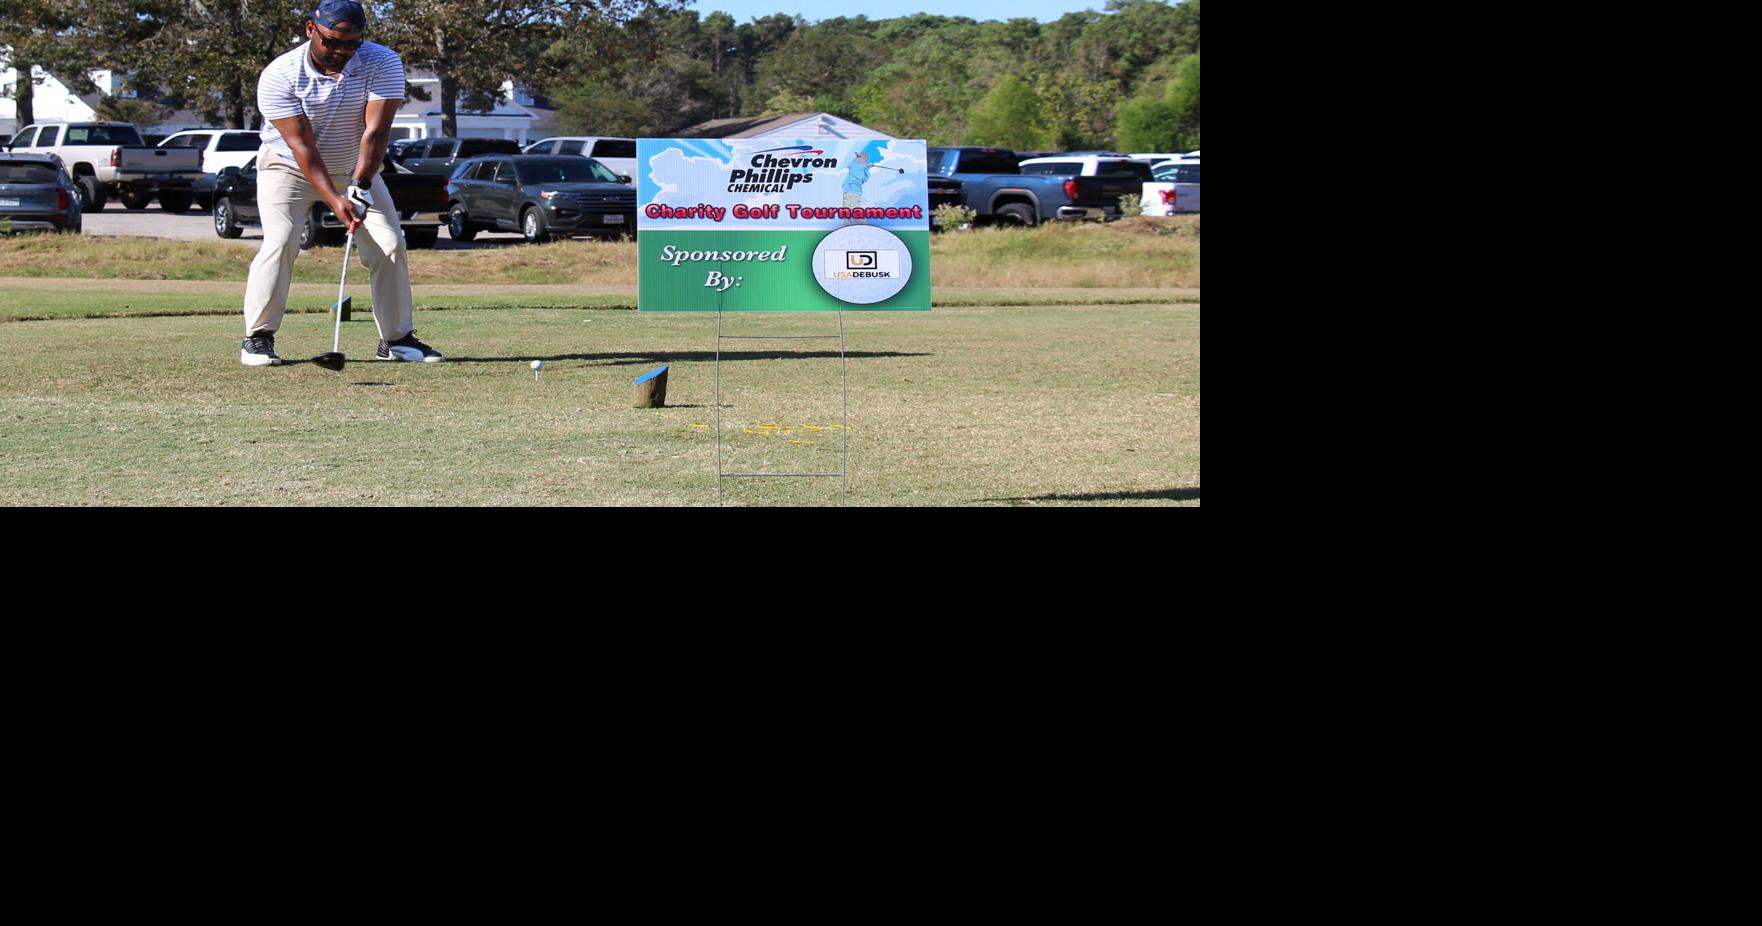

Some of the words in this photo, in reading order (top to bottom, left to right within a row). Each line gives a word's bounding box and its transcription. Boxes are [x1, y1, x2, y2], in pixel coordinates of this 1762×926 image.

[750, 153, 838, 168] Chevron
[727, 183, 785, 193] CHEMICAL
[729, 169, 813, 190] Phillips
[645, 204, 725, 221] Charity
[732, 204, 779, 219] Golf
[786, 204, 922, 219] Tournament
[661, 245, 787, 265] Sponsored
[704, 271, 743, 291] By:
